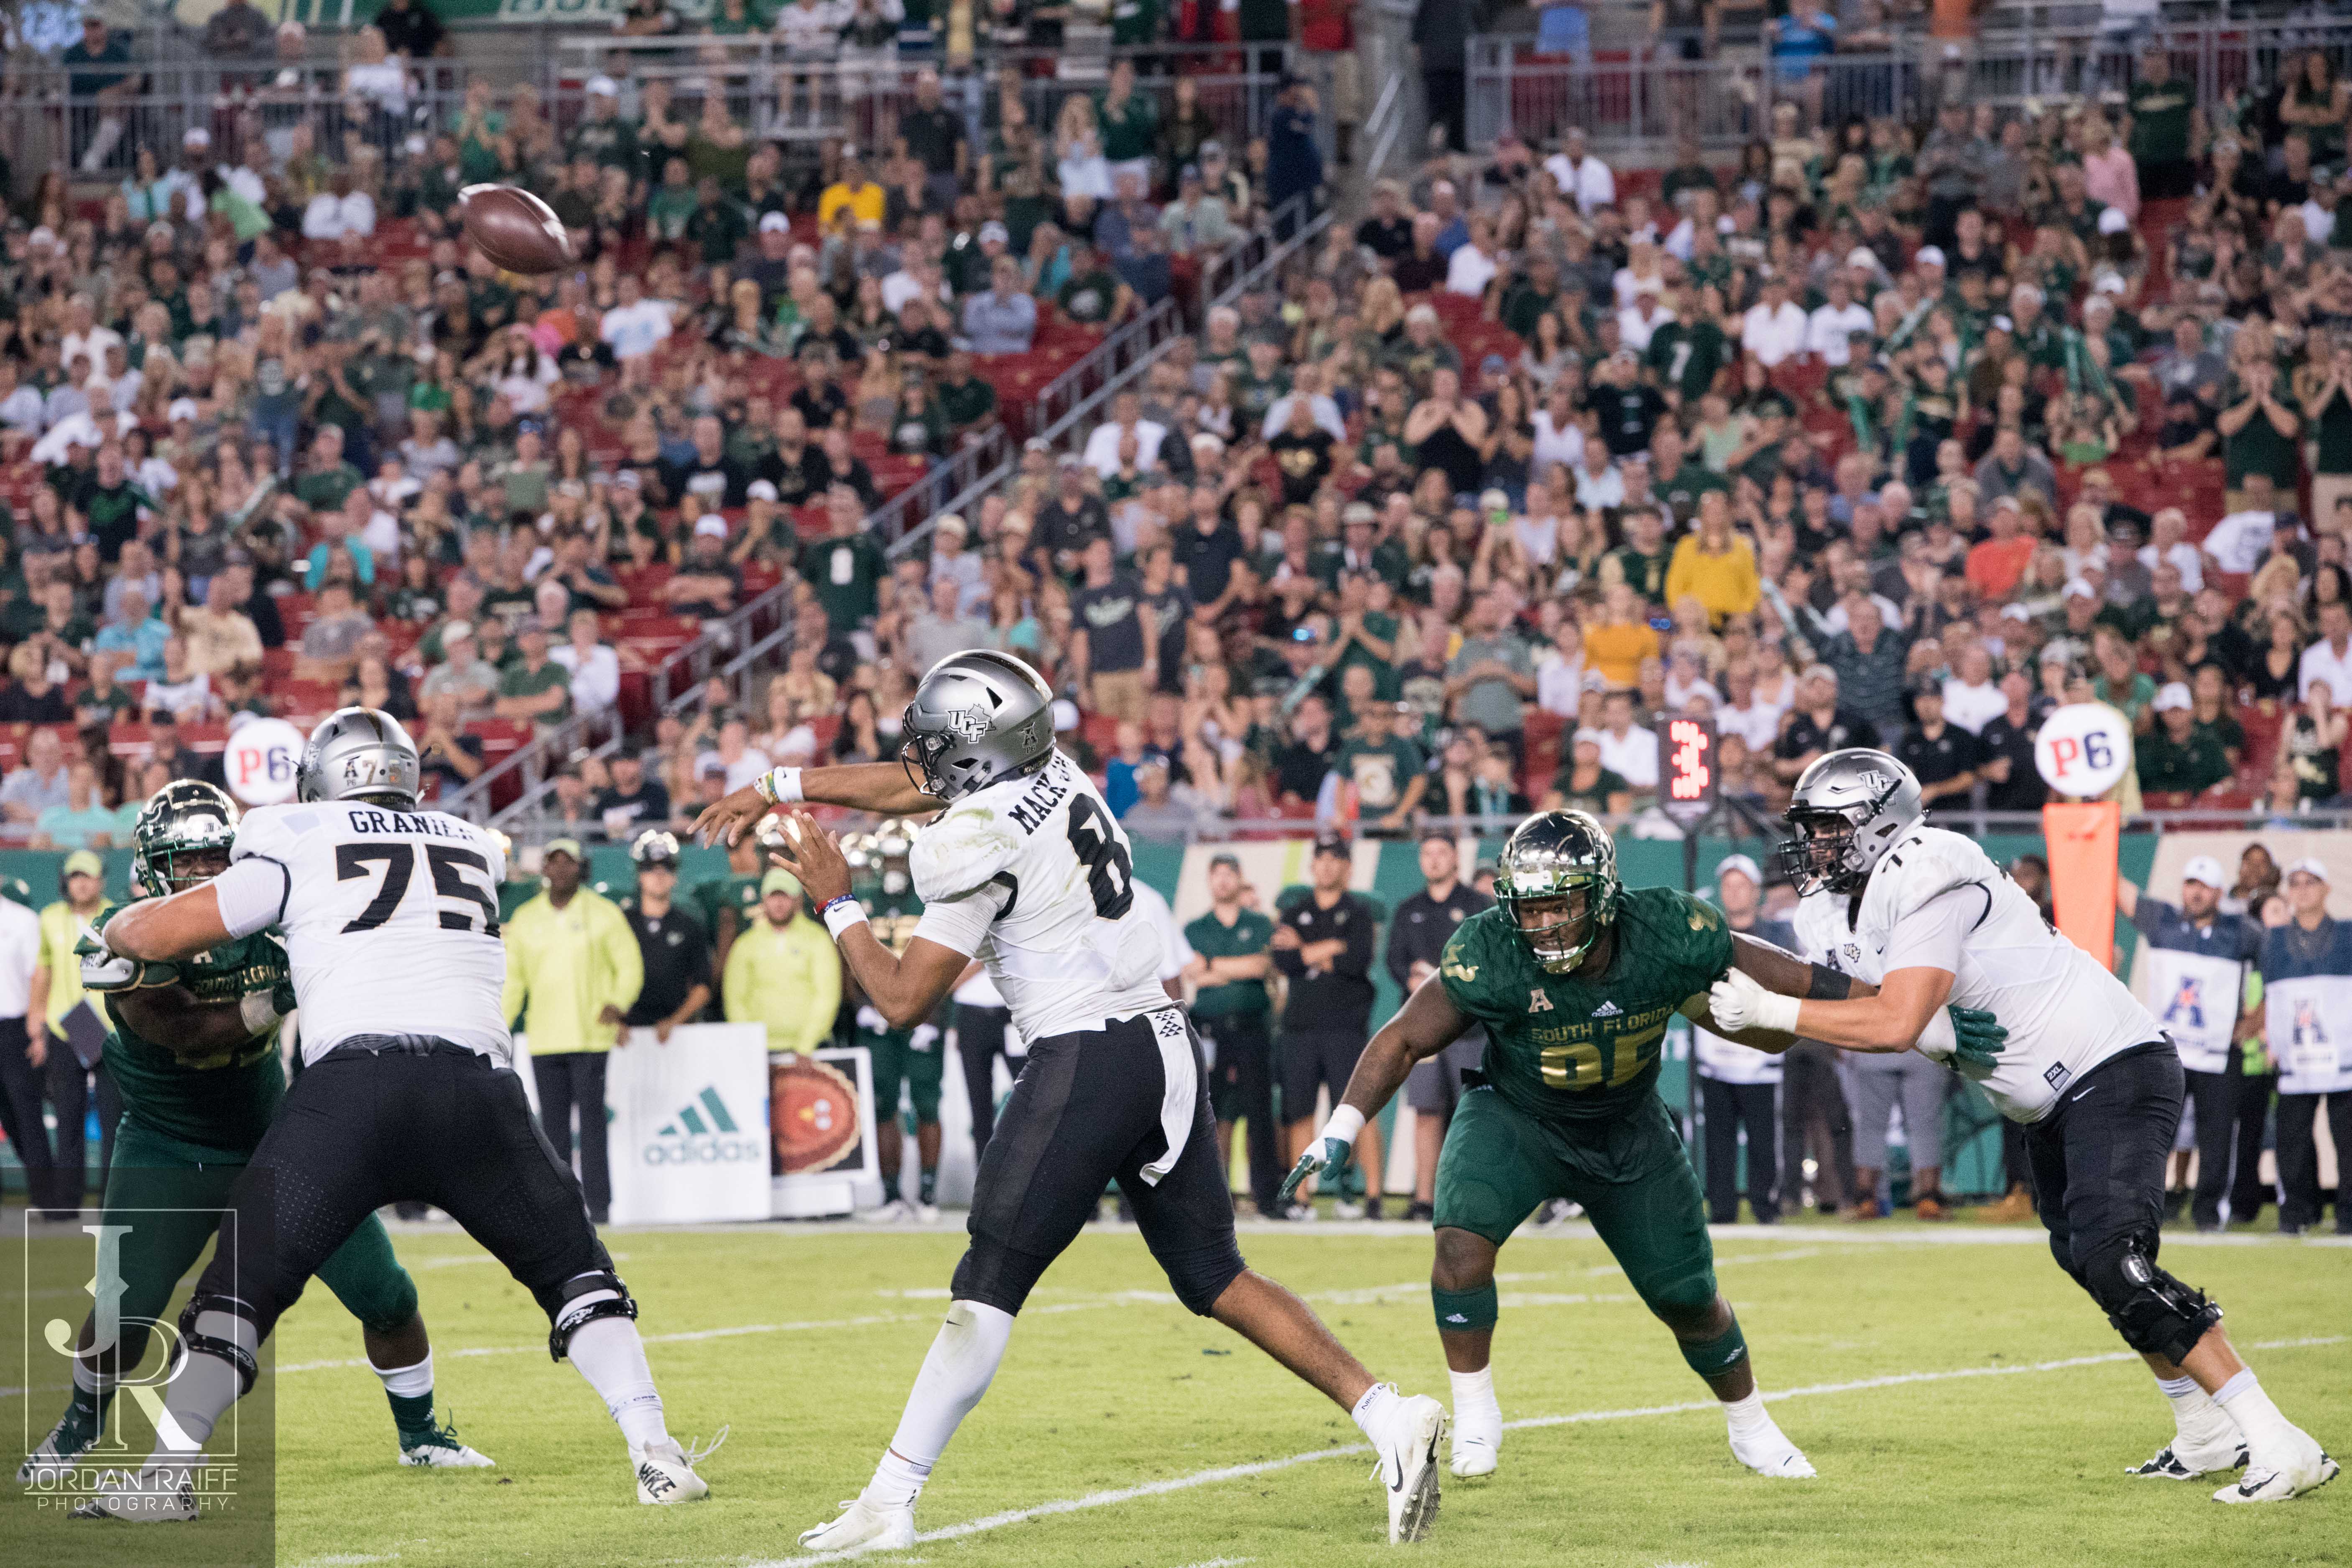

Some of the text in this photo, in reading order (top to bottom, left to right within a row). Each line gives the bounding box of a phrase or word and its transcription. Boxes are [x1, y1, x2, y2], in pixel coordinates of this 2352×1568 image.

[946, 709, 988, 744] UCF
[237, 746, 290, 783] P6
[1671, 719, 1709, 799] 3
[2050, 732, 2113, 777] P6
[1008, 772, 1068, 836] MACK
[1067, 792, 1134, 921] 8
[335, 843, 501, 939] 75
[1843, 943, 1861, 963] UCF
[1528, 988, 1554, 1013] A
[1531, 1022, 1593, 1043] SOUTH
[2047, 1066, 2063, 1080] 2XL
[643, 1137, 760, 1165] adidas
[1361, 1390, 1378, 1410] NIKE
